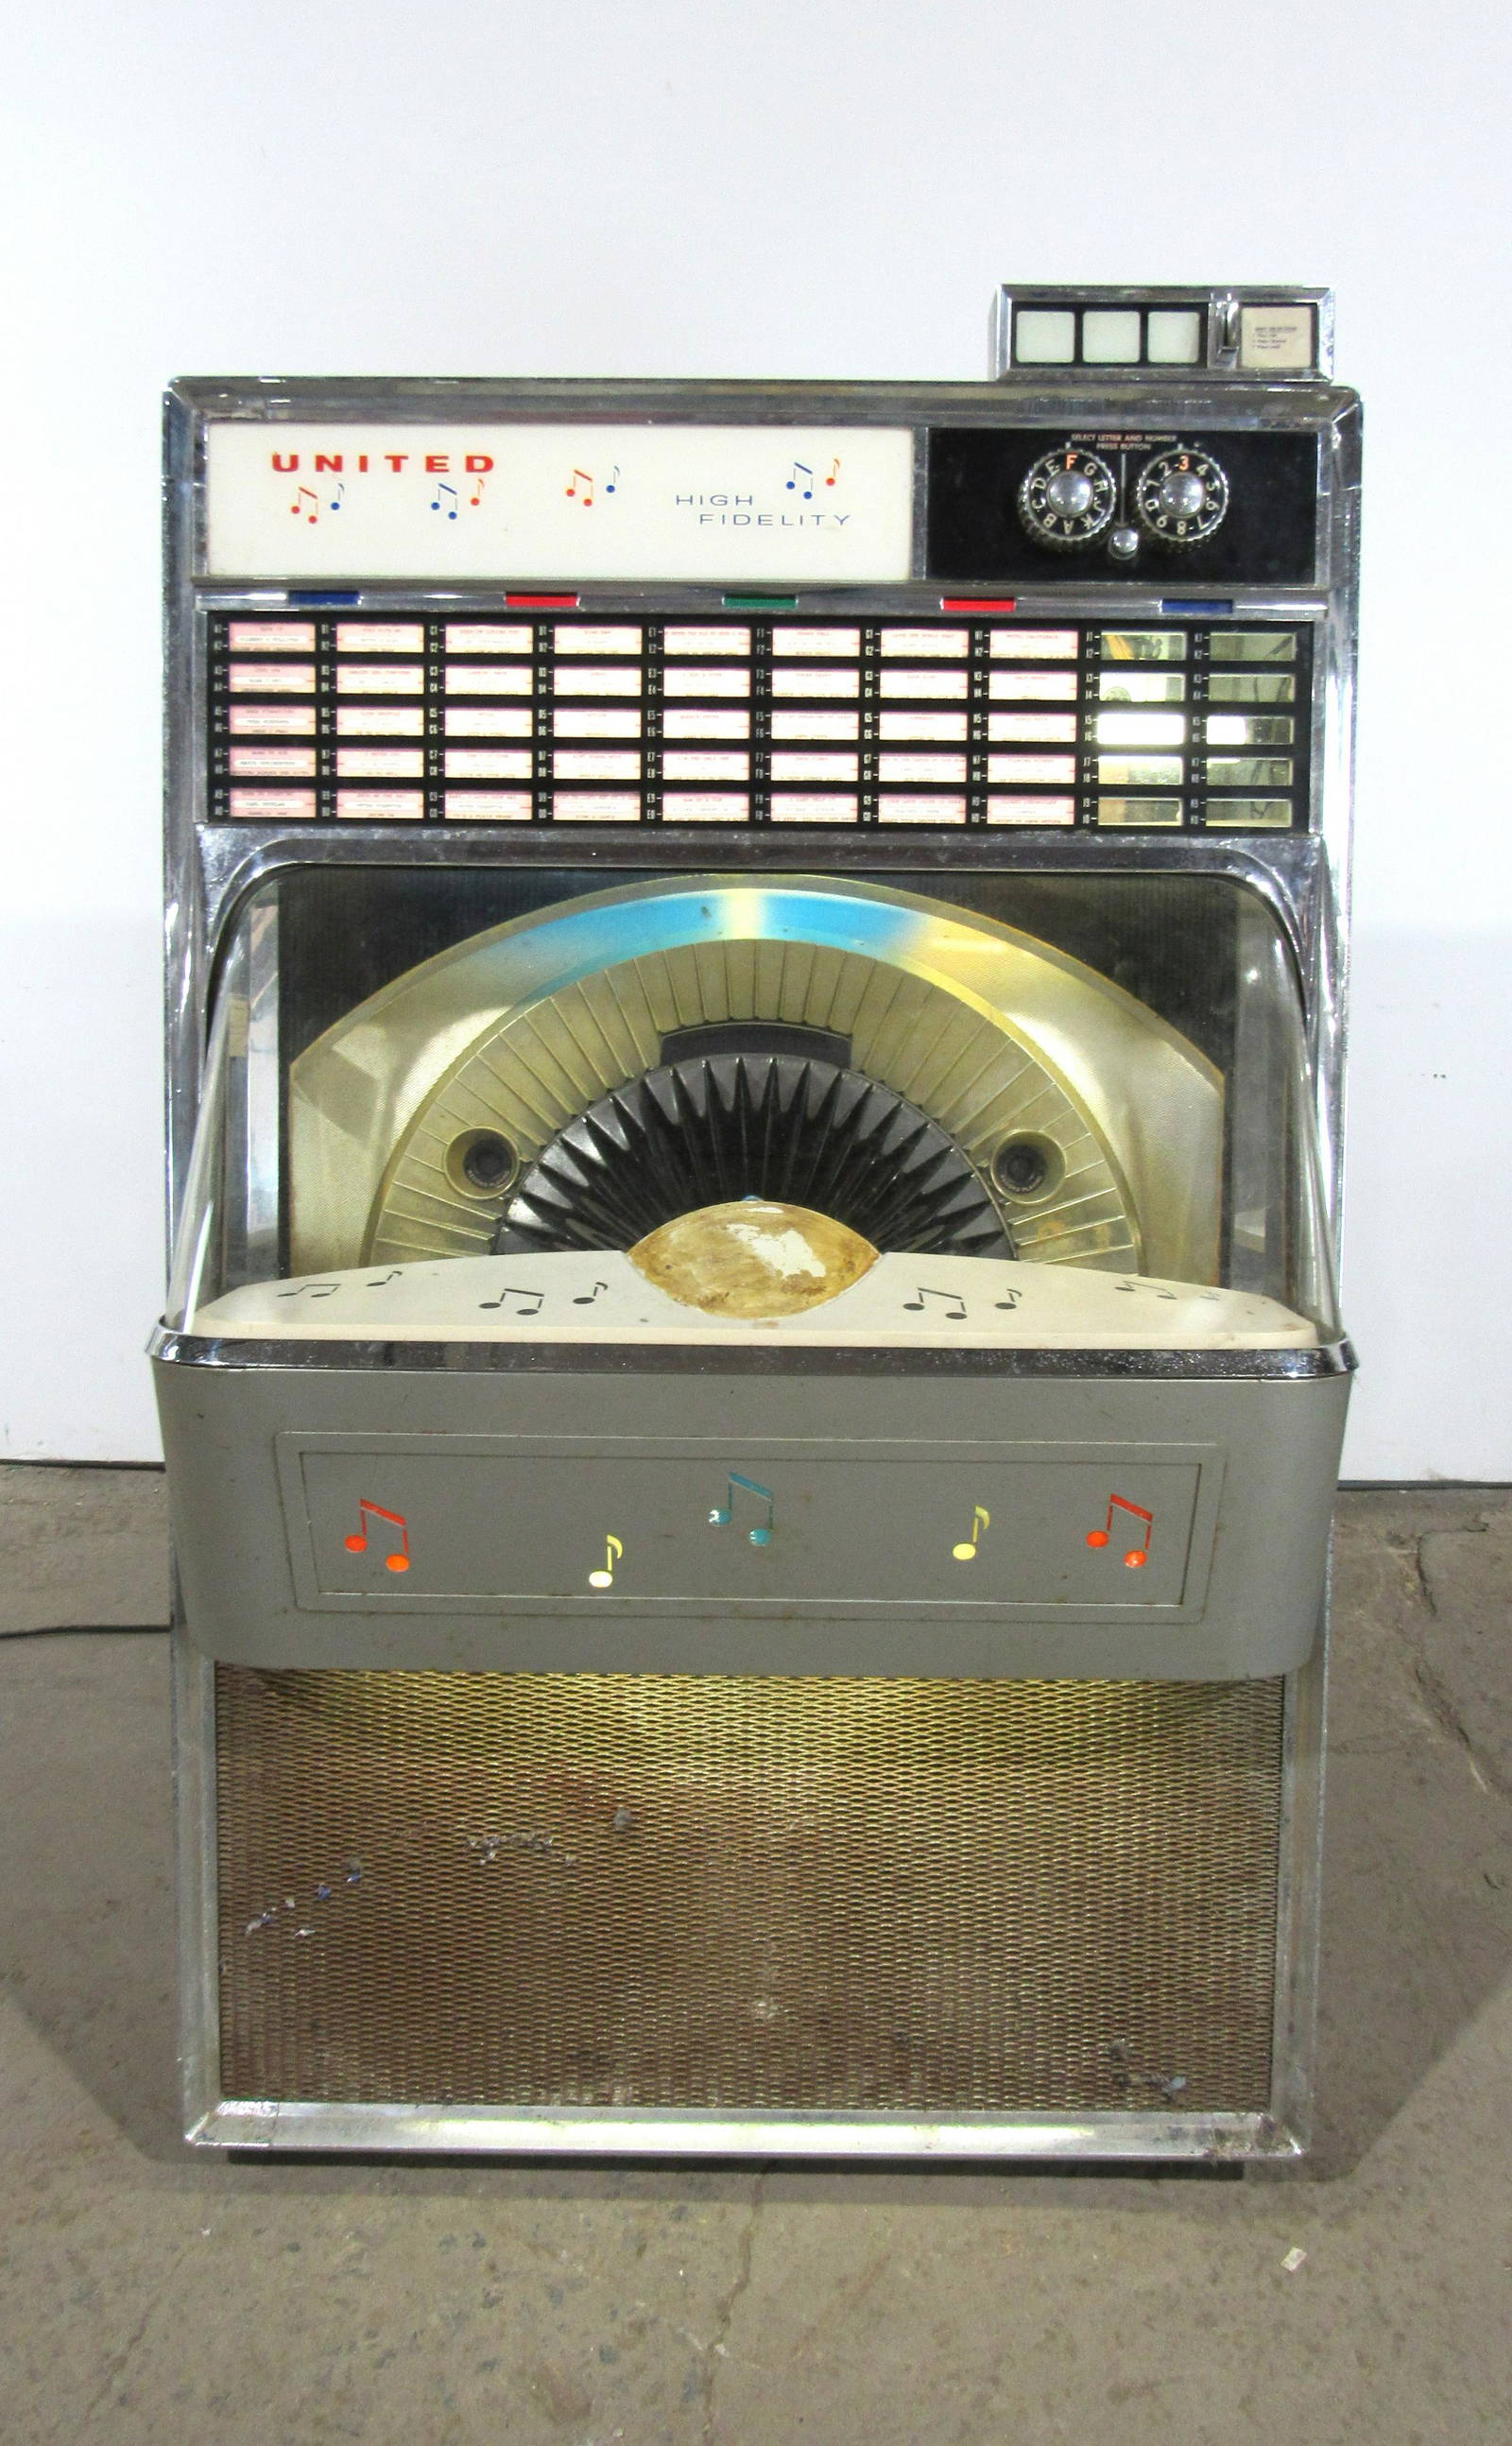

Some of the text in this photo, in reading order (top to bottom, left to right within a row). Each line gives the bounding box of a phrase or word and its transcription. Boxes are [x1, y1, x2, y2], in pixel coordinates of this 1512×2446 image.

[271, 453, 494, 474] UNITED
[1065, 454, 1078, 470] F
[1178, 455, 1190, 471] 3
[676, 494, 753, 507] HIGH
[699, 513, 850, 526] FIDELITY
